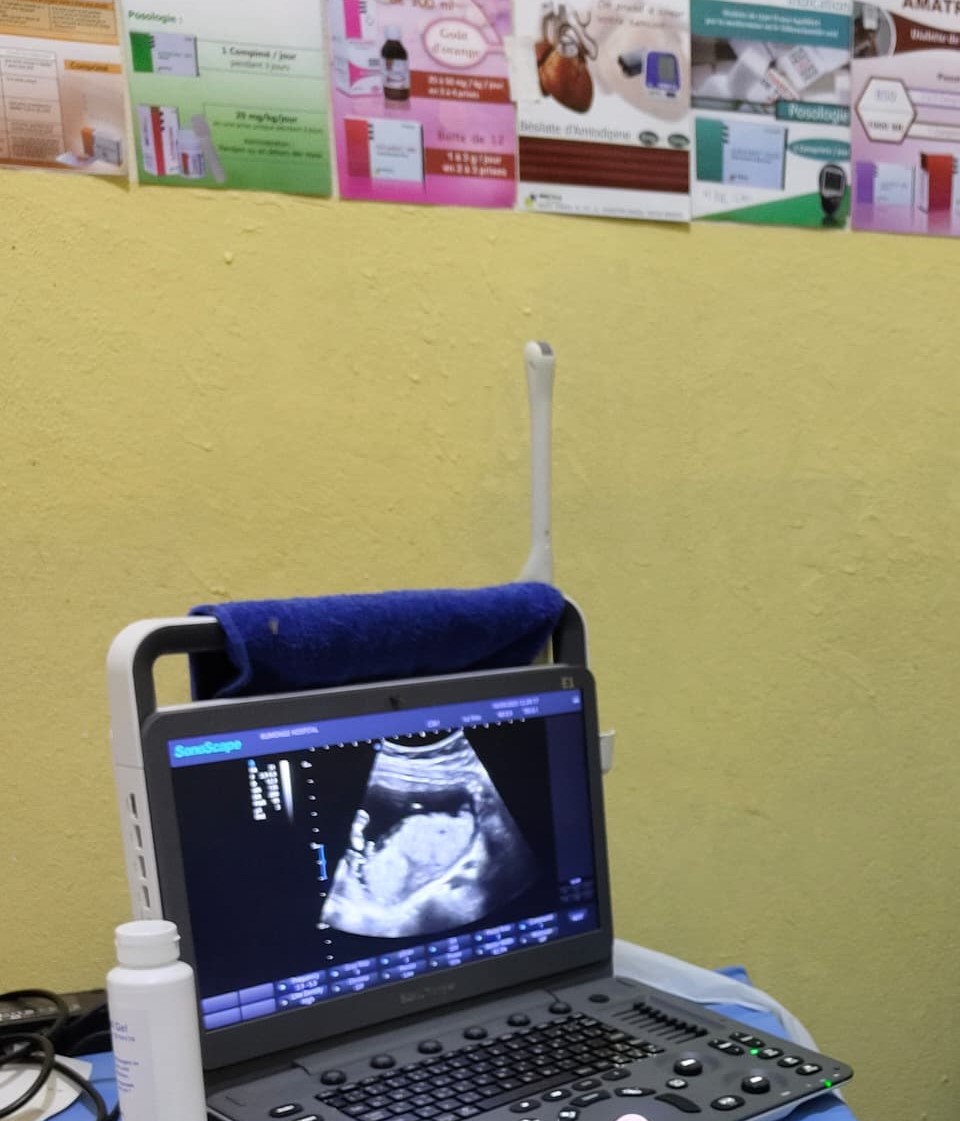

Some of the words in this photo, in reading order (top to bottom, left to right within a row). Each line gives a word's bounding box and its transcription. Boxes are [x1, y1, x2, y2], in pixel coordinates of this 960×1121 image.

[128, 10, 177, 24] Posologie
[279, 51, 297, 61] jour
[787, 102, 850, 125] Posologie
[471, 133, 486, 144] de
[478, 164, 508, 177] prises
[174, 739, 242, 758] SonoScape
[115, 1022, 128, 1033] Gel
